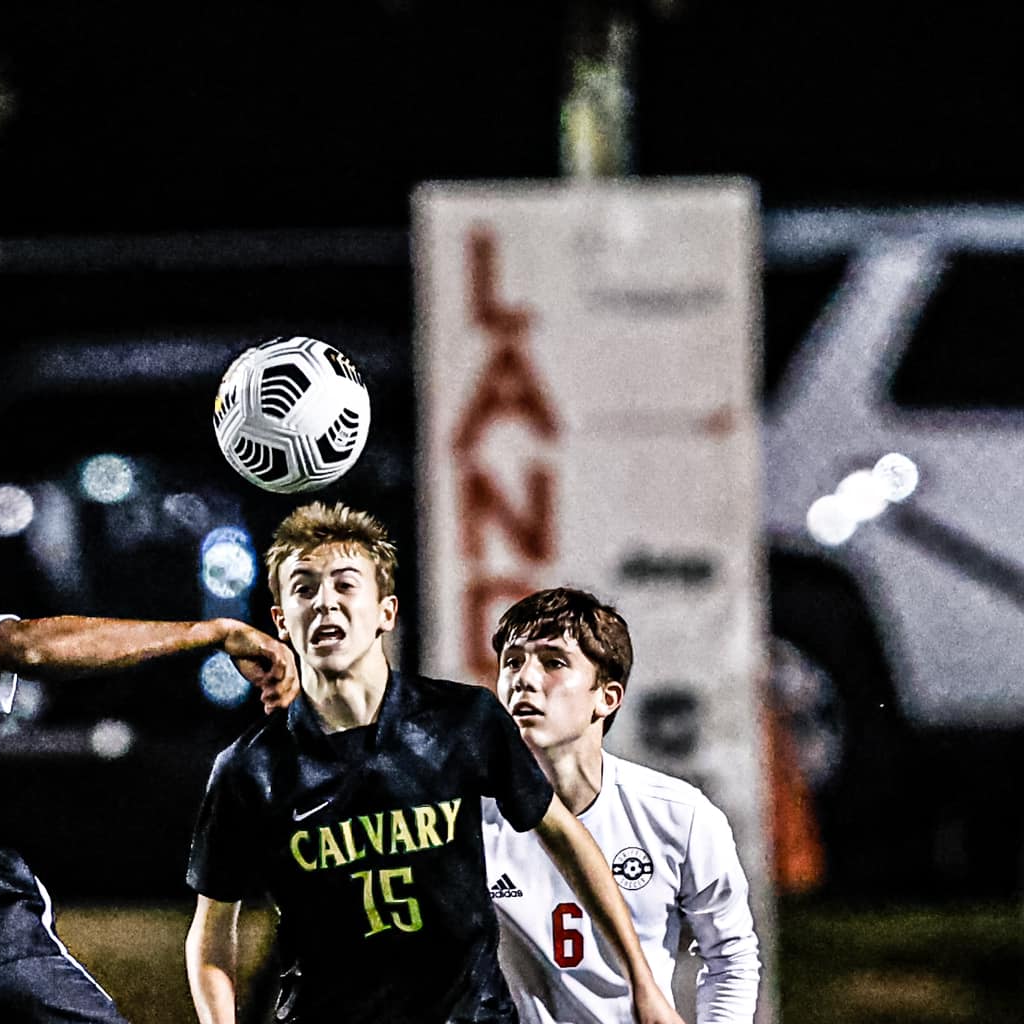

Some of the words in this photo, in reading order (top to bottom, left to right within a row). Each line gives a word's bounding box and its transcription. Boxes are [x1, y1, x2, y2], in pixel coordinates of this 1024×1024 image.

[289, 798, 462, 872] CALVARY
[350, 866, 424, 939] 15
[488, 888, 523, 899] adidas
[552, 903, 584, 968] 6
